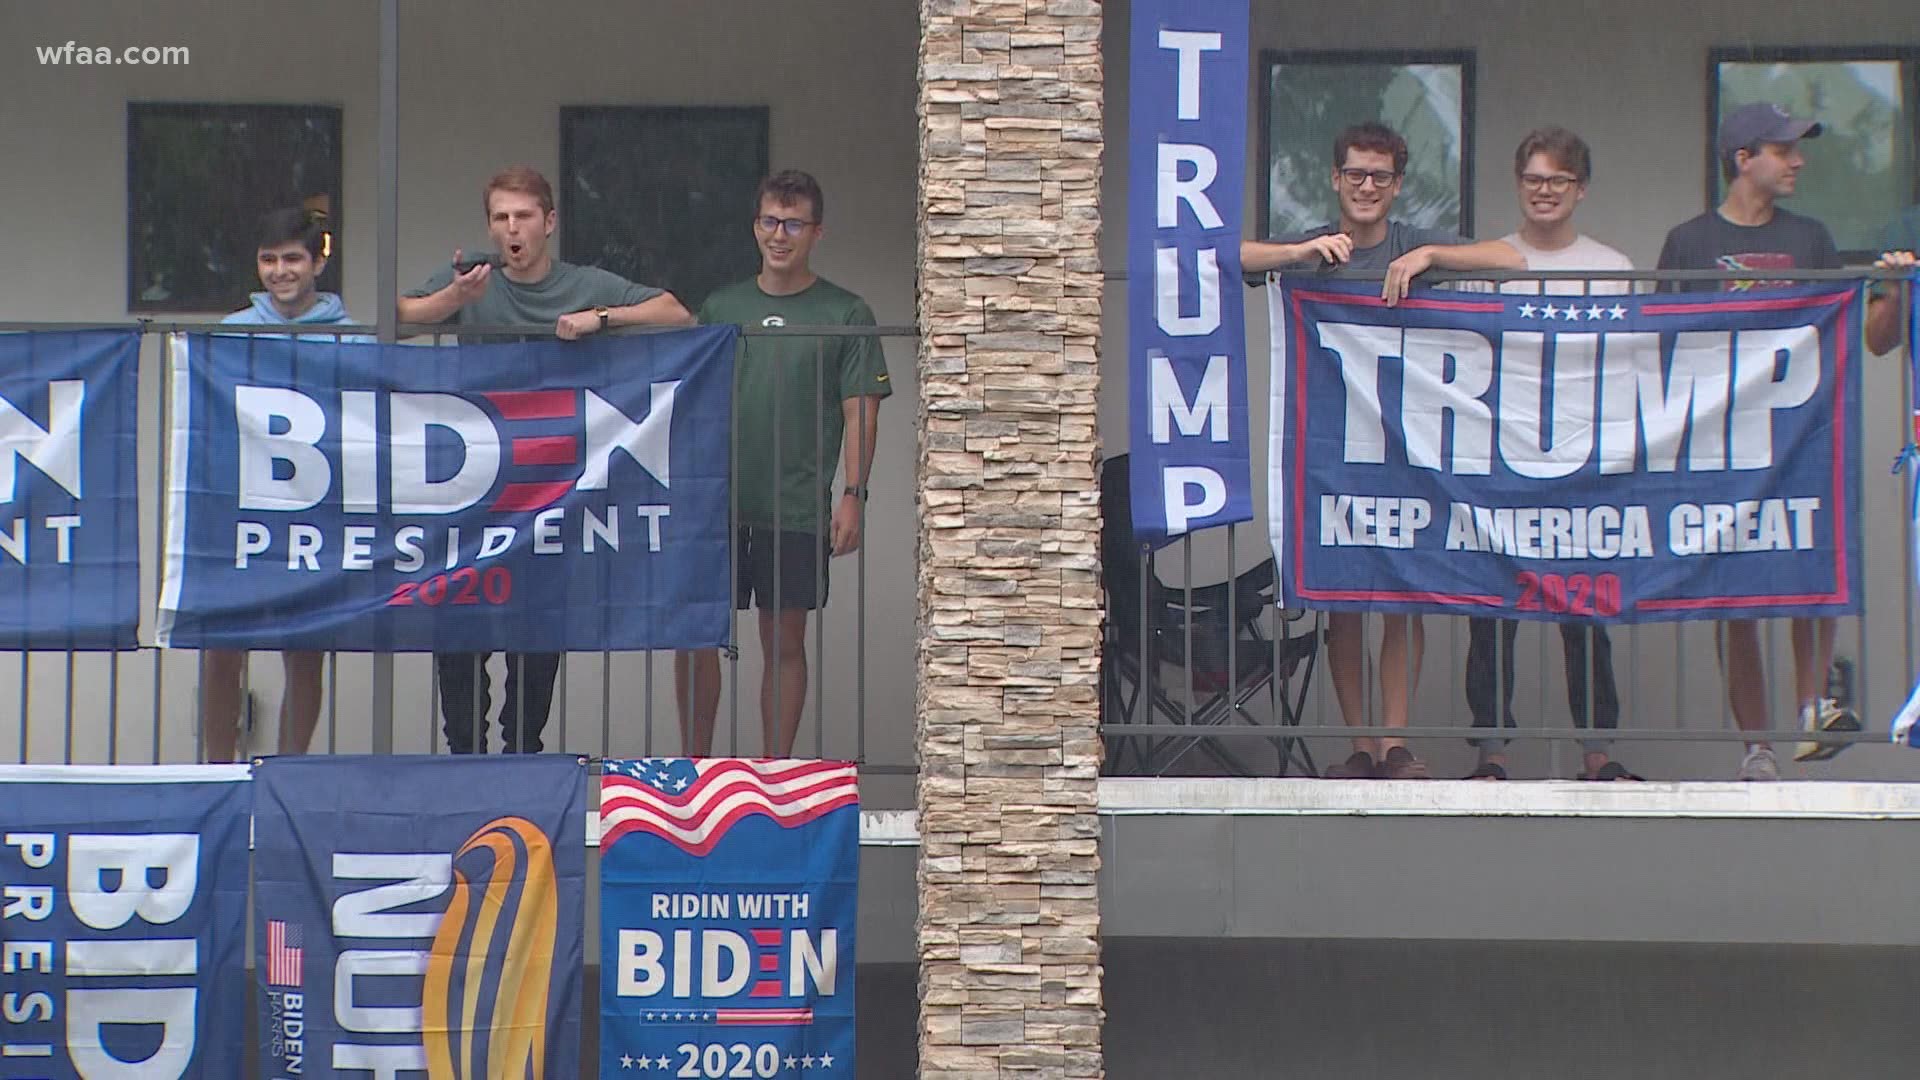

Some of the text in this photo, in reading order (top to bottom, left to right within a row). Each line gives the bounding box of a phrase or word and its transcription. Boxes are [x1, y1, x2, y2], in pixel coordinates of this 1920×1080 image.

[1151, 30, 1228, 536] TRUMP
[1316, 321, 1821, 479] TRUMP
[234, 379, 683, 515] BIDEN
[235, 504, 671, 573] PRESIDENT
[1320, 494, 1821, 559] KEEP AMERICA GREAT
[386, 567, 513, 607] 2020
[1515, 571, 1623, 617] 2020
[651, 893, 810, 919] RIDIN WITH
[616, 928, 838, 998] BIDEN
[267, 991, 284, 1058] HARRIS
[283, 991, 304, 1075] BIDEN
[676, 1043, 780, 1079] 2020
